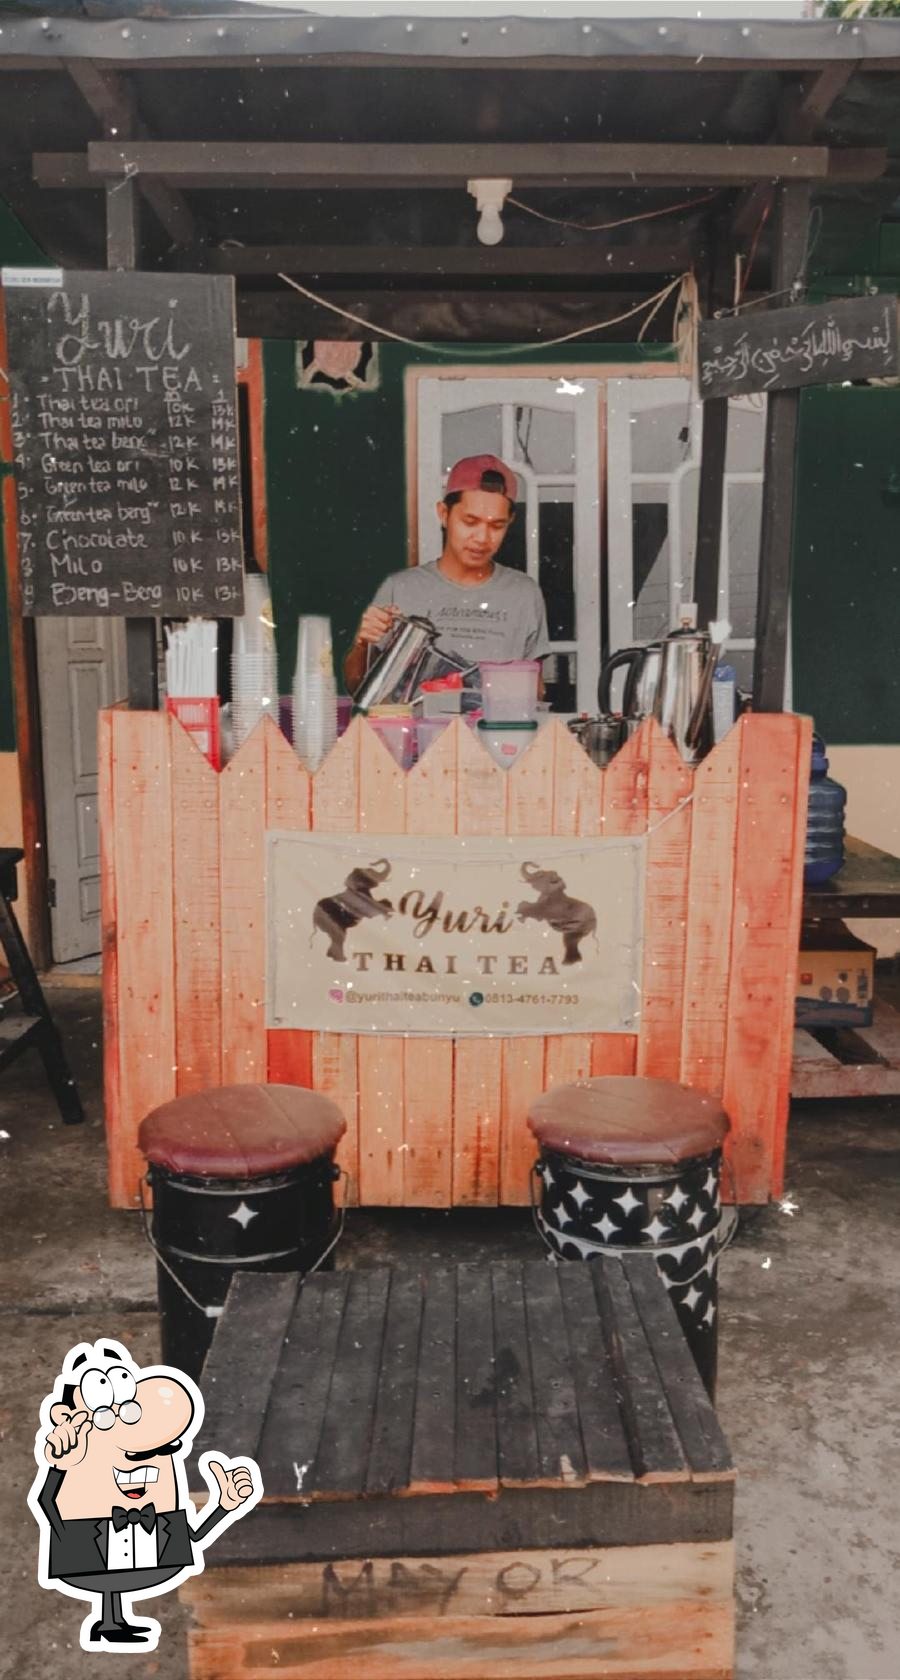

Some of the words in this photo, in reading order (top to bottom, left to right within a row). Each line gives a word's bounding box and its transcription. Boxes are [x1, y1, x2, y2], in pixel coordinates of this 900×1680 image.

[47, 291, 192, 365] Yuri
[53, 365, 123, 392] THAI
[136, 365, 202, 392] TEA
[79, 394, 110, 412] tea
[37, 412, 74, 429] Thai
[78, 412, 102, 429] tea
[38, 432, 79, 450] Thai
[82, 433, 106, 450] tea
[87, 454, 111, 473] tea
[89, 477, 111, 493] tea
[398, 889, 515, 939] Yuri
[353, 952, 457, 974] THAI
[477, 955, 560, 976] TEA
